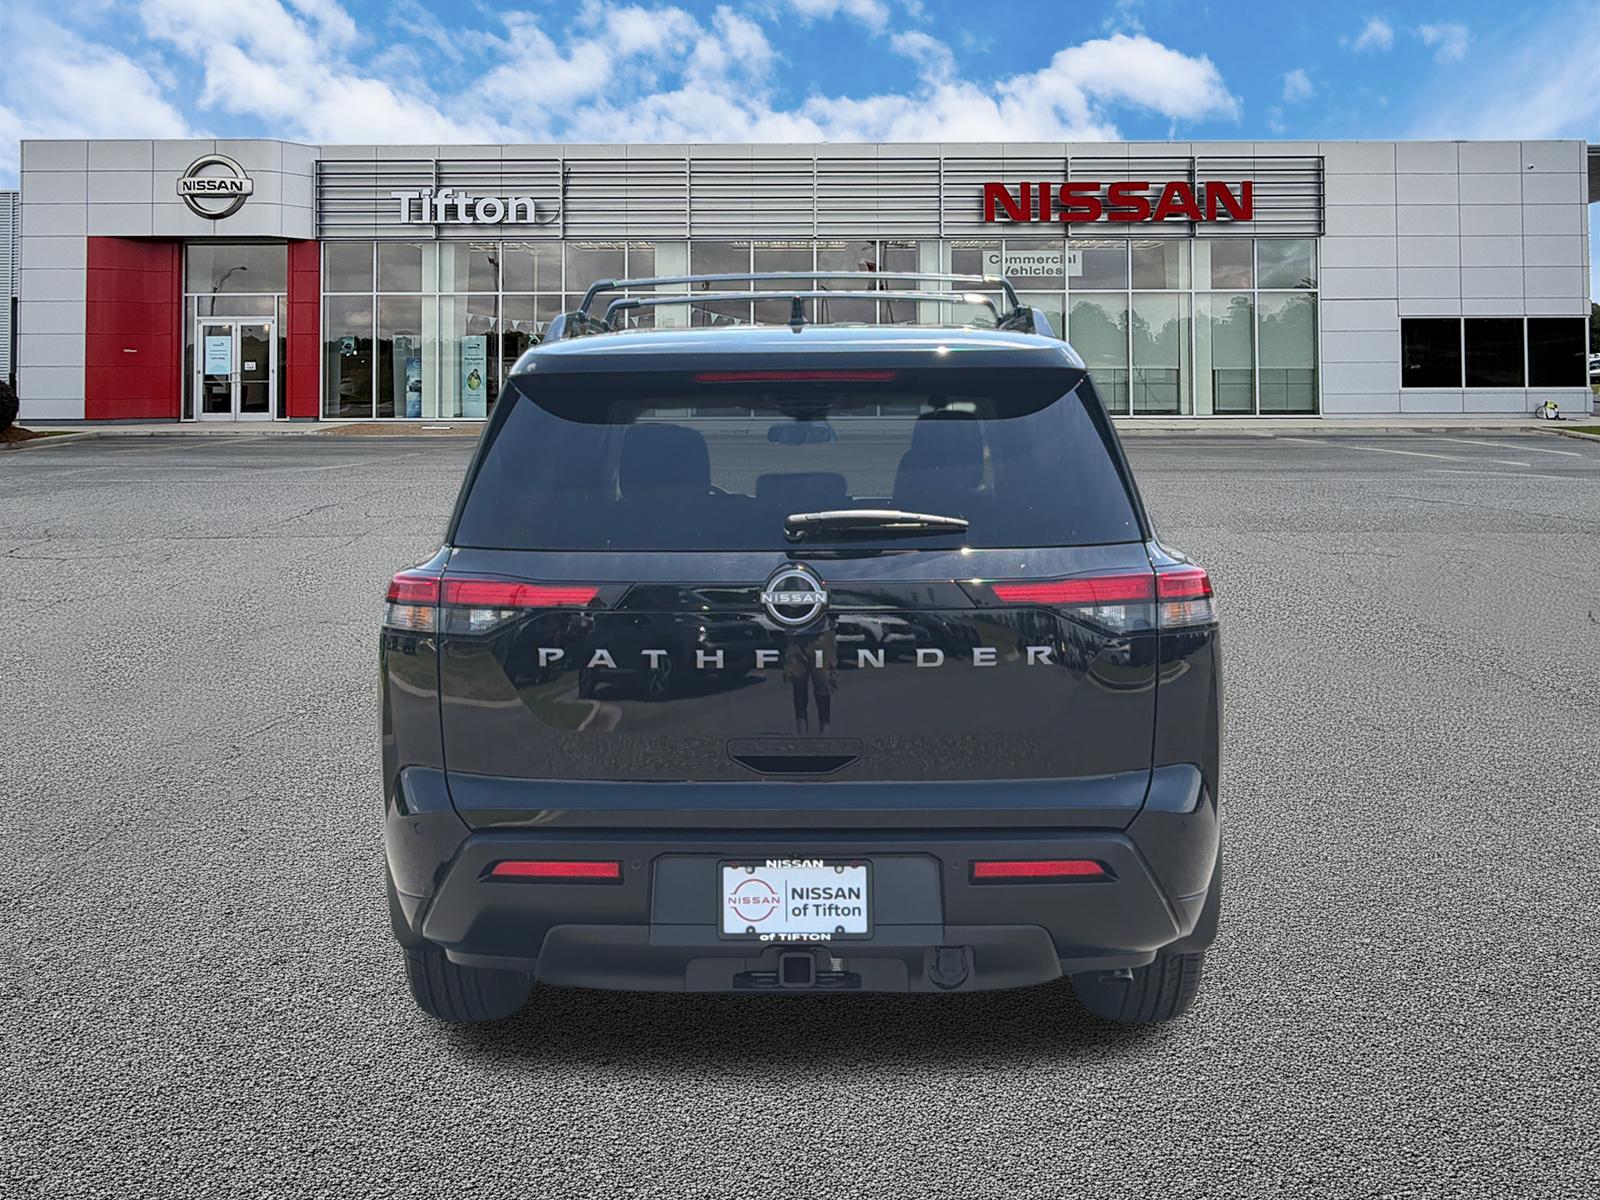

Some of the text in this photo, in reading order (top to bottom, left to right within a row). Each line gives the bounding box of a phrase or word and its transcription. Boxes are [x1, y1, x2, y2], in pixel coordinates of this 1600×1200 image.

[183, 181, 243, 191] NISSAN
[391, 188, 536, 224] Tifton
[983, 181, 1253, 222] NISSAN
[989, 254, 1077, 264] Cmmercil
[762, 594, 825, 603] NISSAN
[538, 645, 1055, 670] PATHFINDER
[766, 860, 824, 869] NISSAN
[791, 887, 861, 900] NISSAN
[791, 904, 862, 917] of Tifton
[760, 933, 831, 941] of TIFTON
